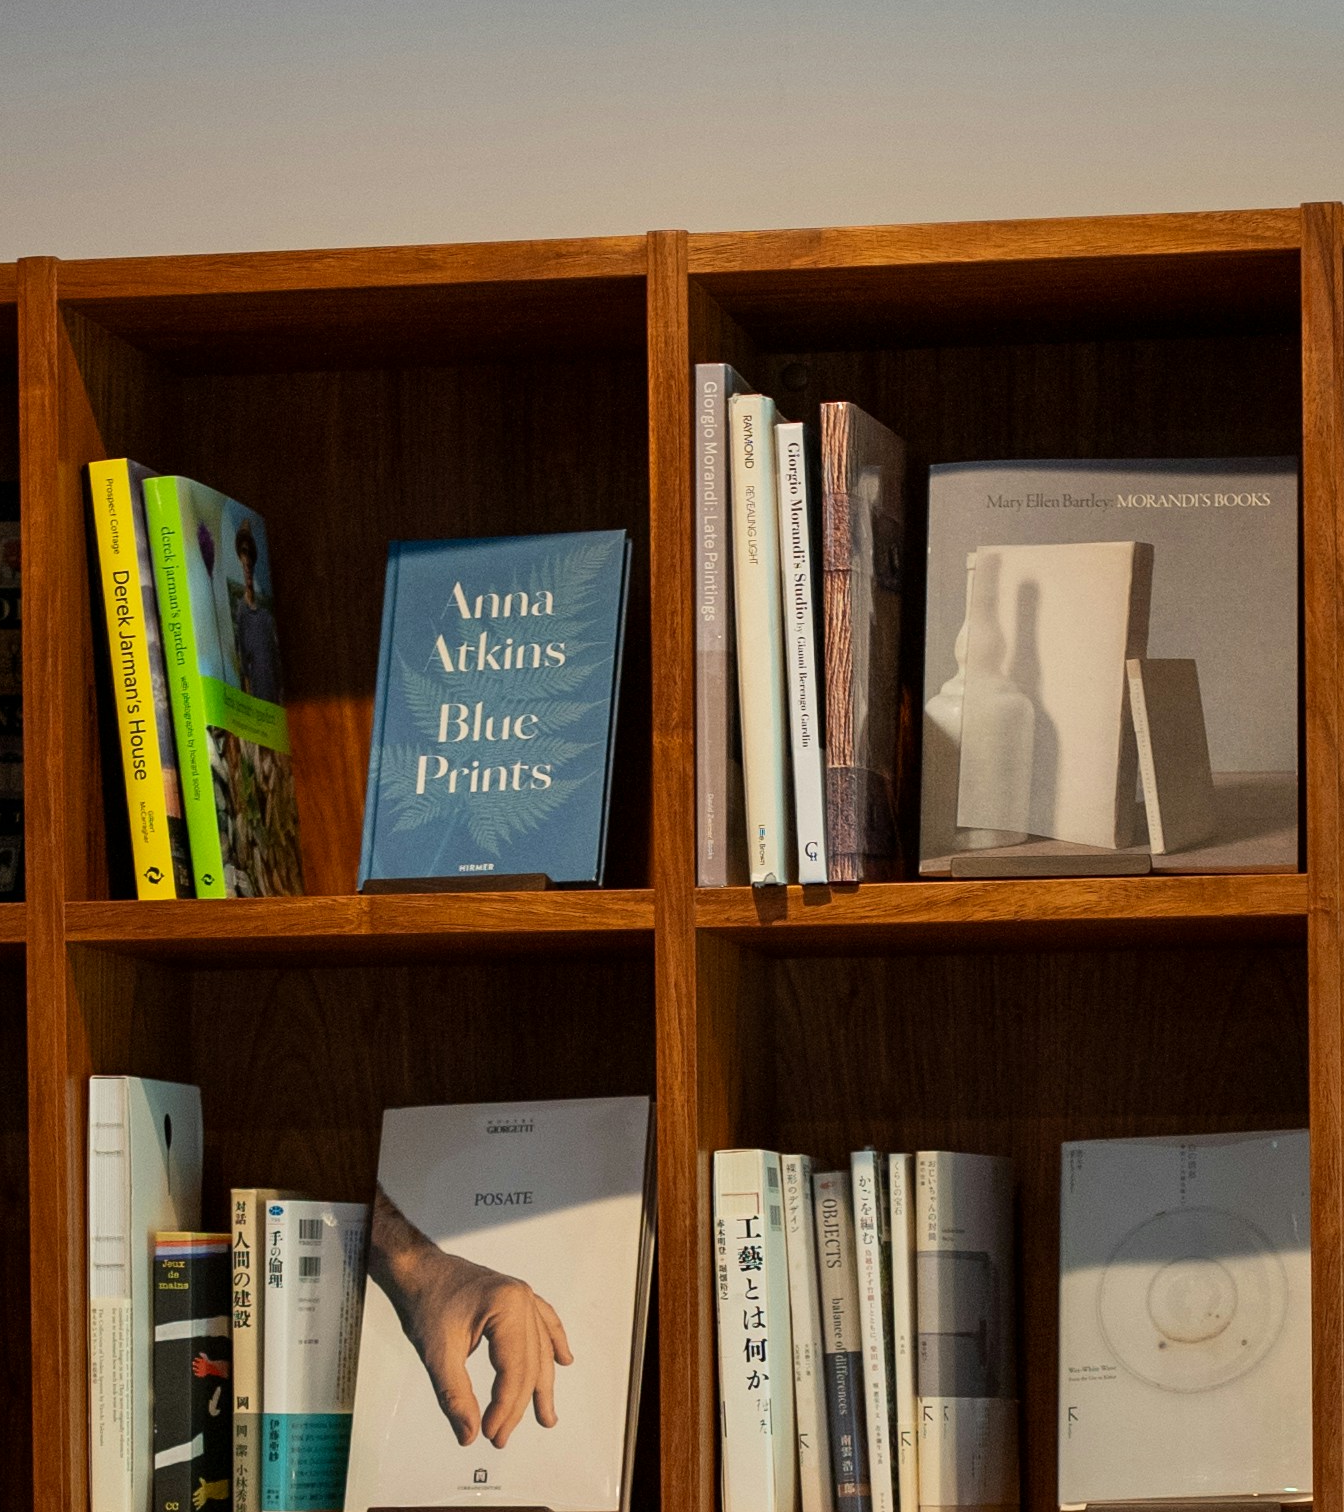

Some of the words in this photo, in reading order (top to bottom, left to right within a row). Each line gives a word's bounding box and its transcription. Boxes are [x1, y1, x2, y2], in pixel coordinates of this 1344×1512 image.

[701, 381, 718, 439] Giorgio
[742, 415, 755, 469] RAYMOND
[704, 442, 718, 511] Morandi:
[787, 442, 802, 495] Giorgio
[106, 478, 116, 516] Prospect
[745, 485, 757, 537] REVEALING
[986, 494, 1023, 512] Mary
[1026, 493, 1060, 508] Ellen
[1063, 493, 1114, 512] Bartley:
[1117, 493, 1211, 508] MORANDI'S
[1214, 492, 1271, 507] BOOKS
[109, 520, 120, 555] Cottage
[161, 526, 176, 562] derek
[704, 517, 718, 549] Late
[748, 538, 759, 565] LIGHT
[789, 499, 807, 569] Morandi's
[112, 570, 131, 627] Derek
[163, 565, 181, 618] jarman's
[440, 581, 555, 620] Anna
[702, 551, 718, 622] Paintings
[793, 573, 809, 621] Studio
[169, 622, 187, 666] garden
[423, 631, 567, 673] Atkins
[118, 631, 140, 715] Jarman's
[438, 701, 539, 743] Blue
[128, 720, 147, 781] House
[416, 754, 552, 795] Prints
[459, 863, 494, 872] HIRMER
[235, 1200, 247, 1226] 対話
[475, 1191, 534, 1207] POSATE
[786, 1163, 800, 1234] 裸形のデザイン
[858, 1175, 875, 1245] かごを編む
[893, 1161, 903, 1216] くらしの宝石
[822, 1198, 842, 1269] OBJECTS
[162, 1259, 186, 1269] Jeux
[168, 1271, 180, 1279] de
[233, 1231, 252, 1329] 人間の建設
[267, 1230, 284, 1289] 手の倫理
[159, 1282, 189, 1290] mains
[736, 1215, 770, 1391] 工藝とは何か
[831, 1297, 844, 1338] balance
[834, 1351, 848, 1416] differences
